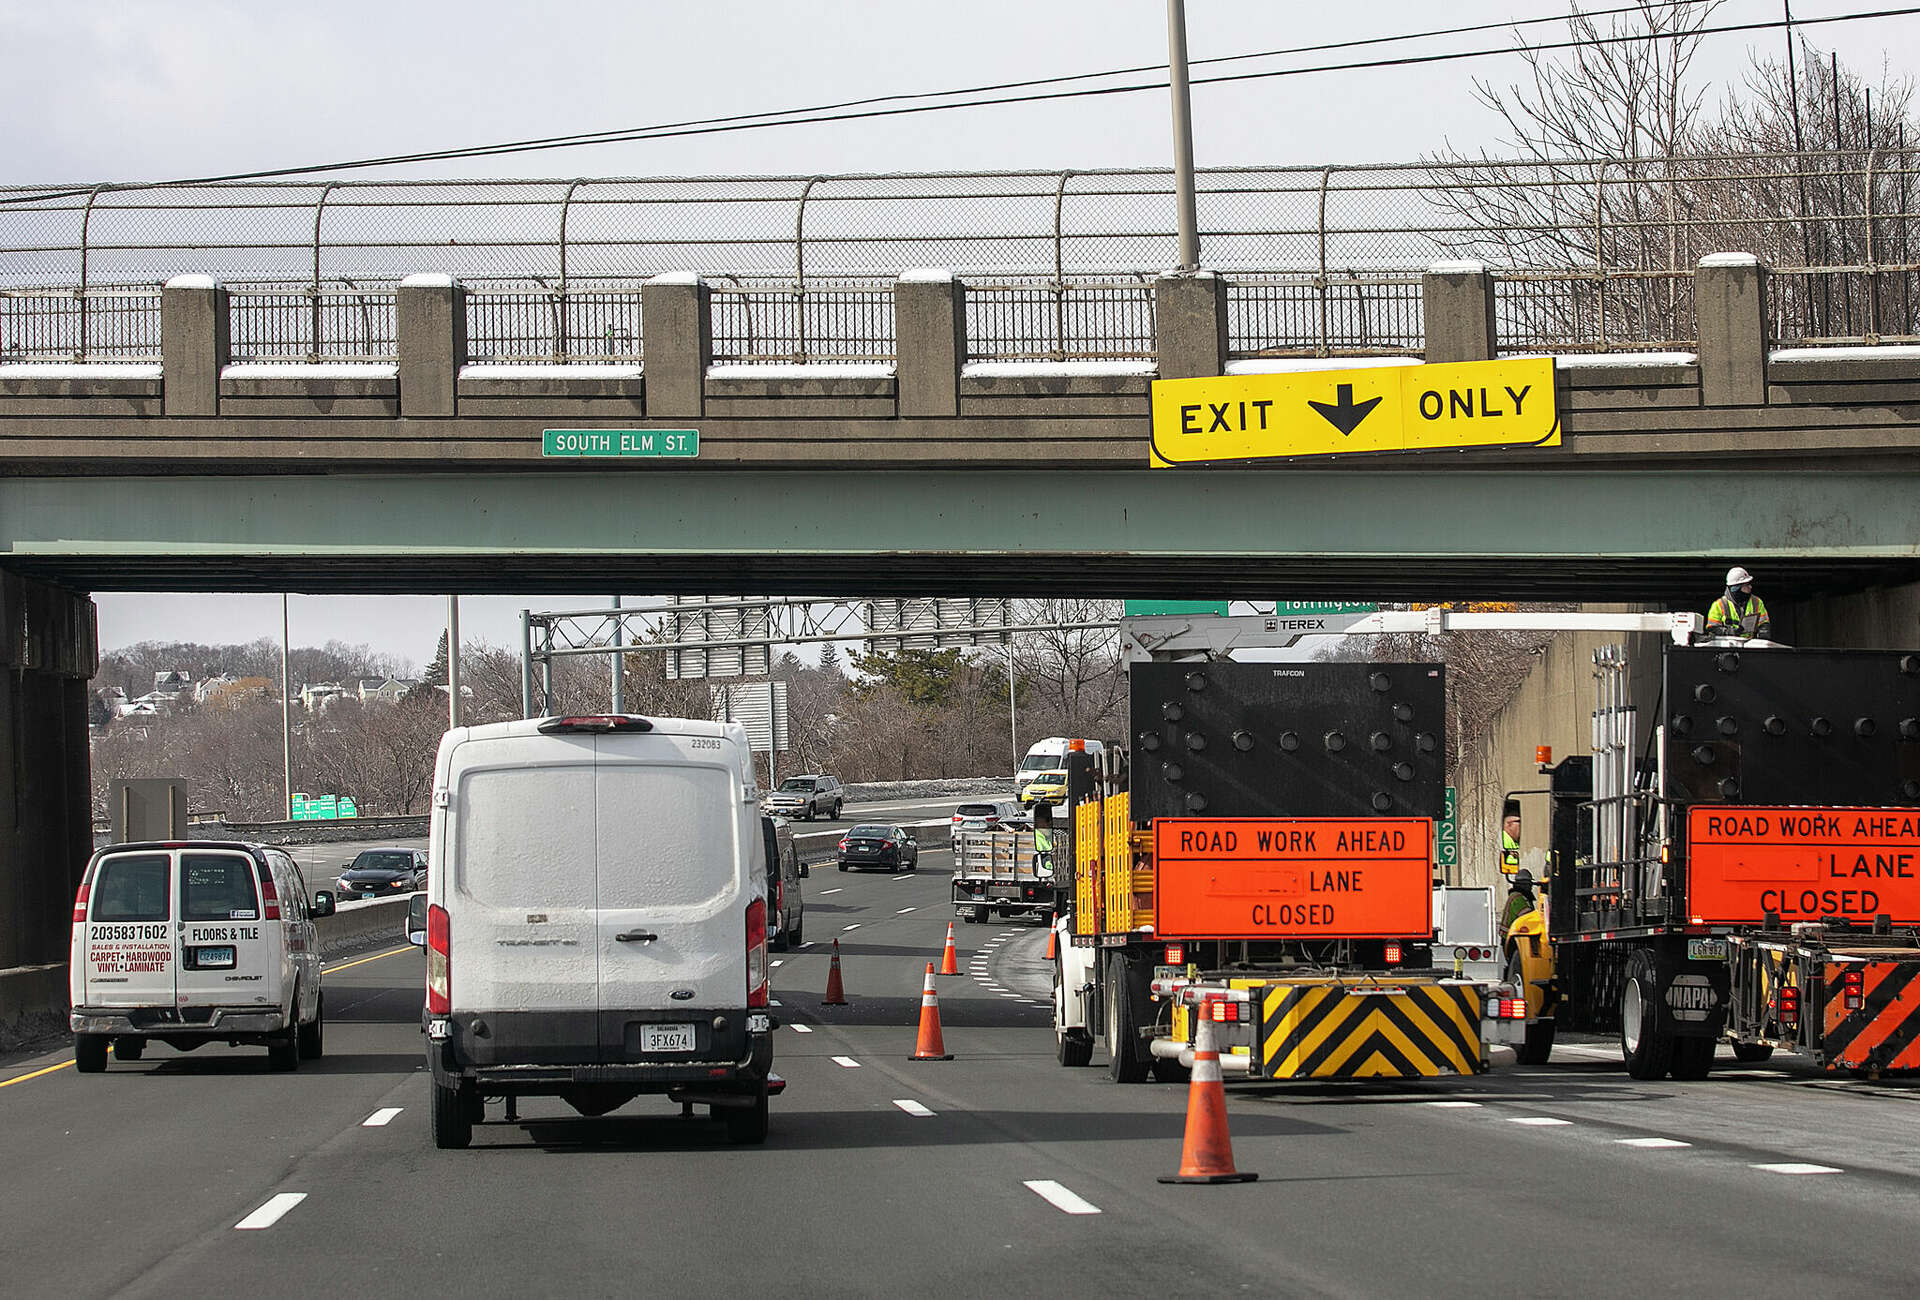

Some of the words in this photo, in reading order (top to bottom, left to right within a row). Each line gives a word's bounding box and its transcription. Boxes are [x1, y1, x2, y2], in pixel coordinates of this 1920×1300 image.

[1181, 399, 1274, 434] EXIT
[1419, 385, 1533, 421] ONLY
[556, 435, 610, 451] SOUTH
[621, 435, 653, 451] ELM
[665, 435, 687, 451] ST.
[1280, 619, 1325, 630] TEREX
[691, 739, 721, 749] 232083
[1708, 817, 1769, 836] ROAD
[1780, 817, 1842, 837] WORK
[1181, 831, 1238, 852] ROAD
[1257, 831, 1316, 852] WORK
[1336, 831, 1405, 851] AHEAD
[1830, 854, 1914, 878] LANE
[1310, 871, 1363, 892] LANE
[1760, 889, 1880, 914] CLOSED
[1252, 904, 1335, 926] CLOSED
[91, 924, 167, 940] 2035837602
[192, 928, 228, 941] FLOORS
[230, 928, 238, 940] &
[240, 927, 259, 940] TILE
[90, 951, 121, 962] CARPET
[126, 951, 172, 962] HARDWOOD
[97, 962, 121, 973] VINYL
[124, 962, 165, 973] LAMINATE
[1673, 986, 1709, 1009] NAPA
[650, 1034, 687, 1047] 3FX674
